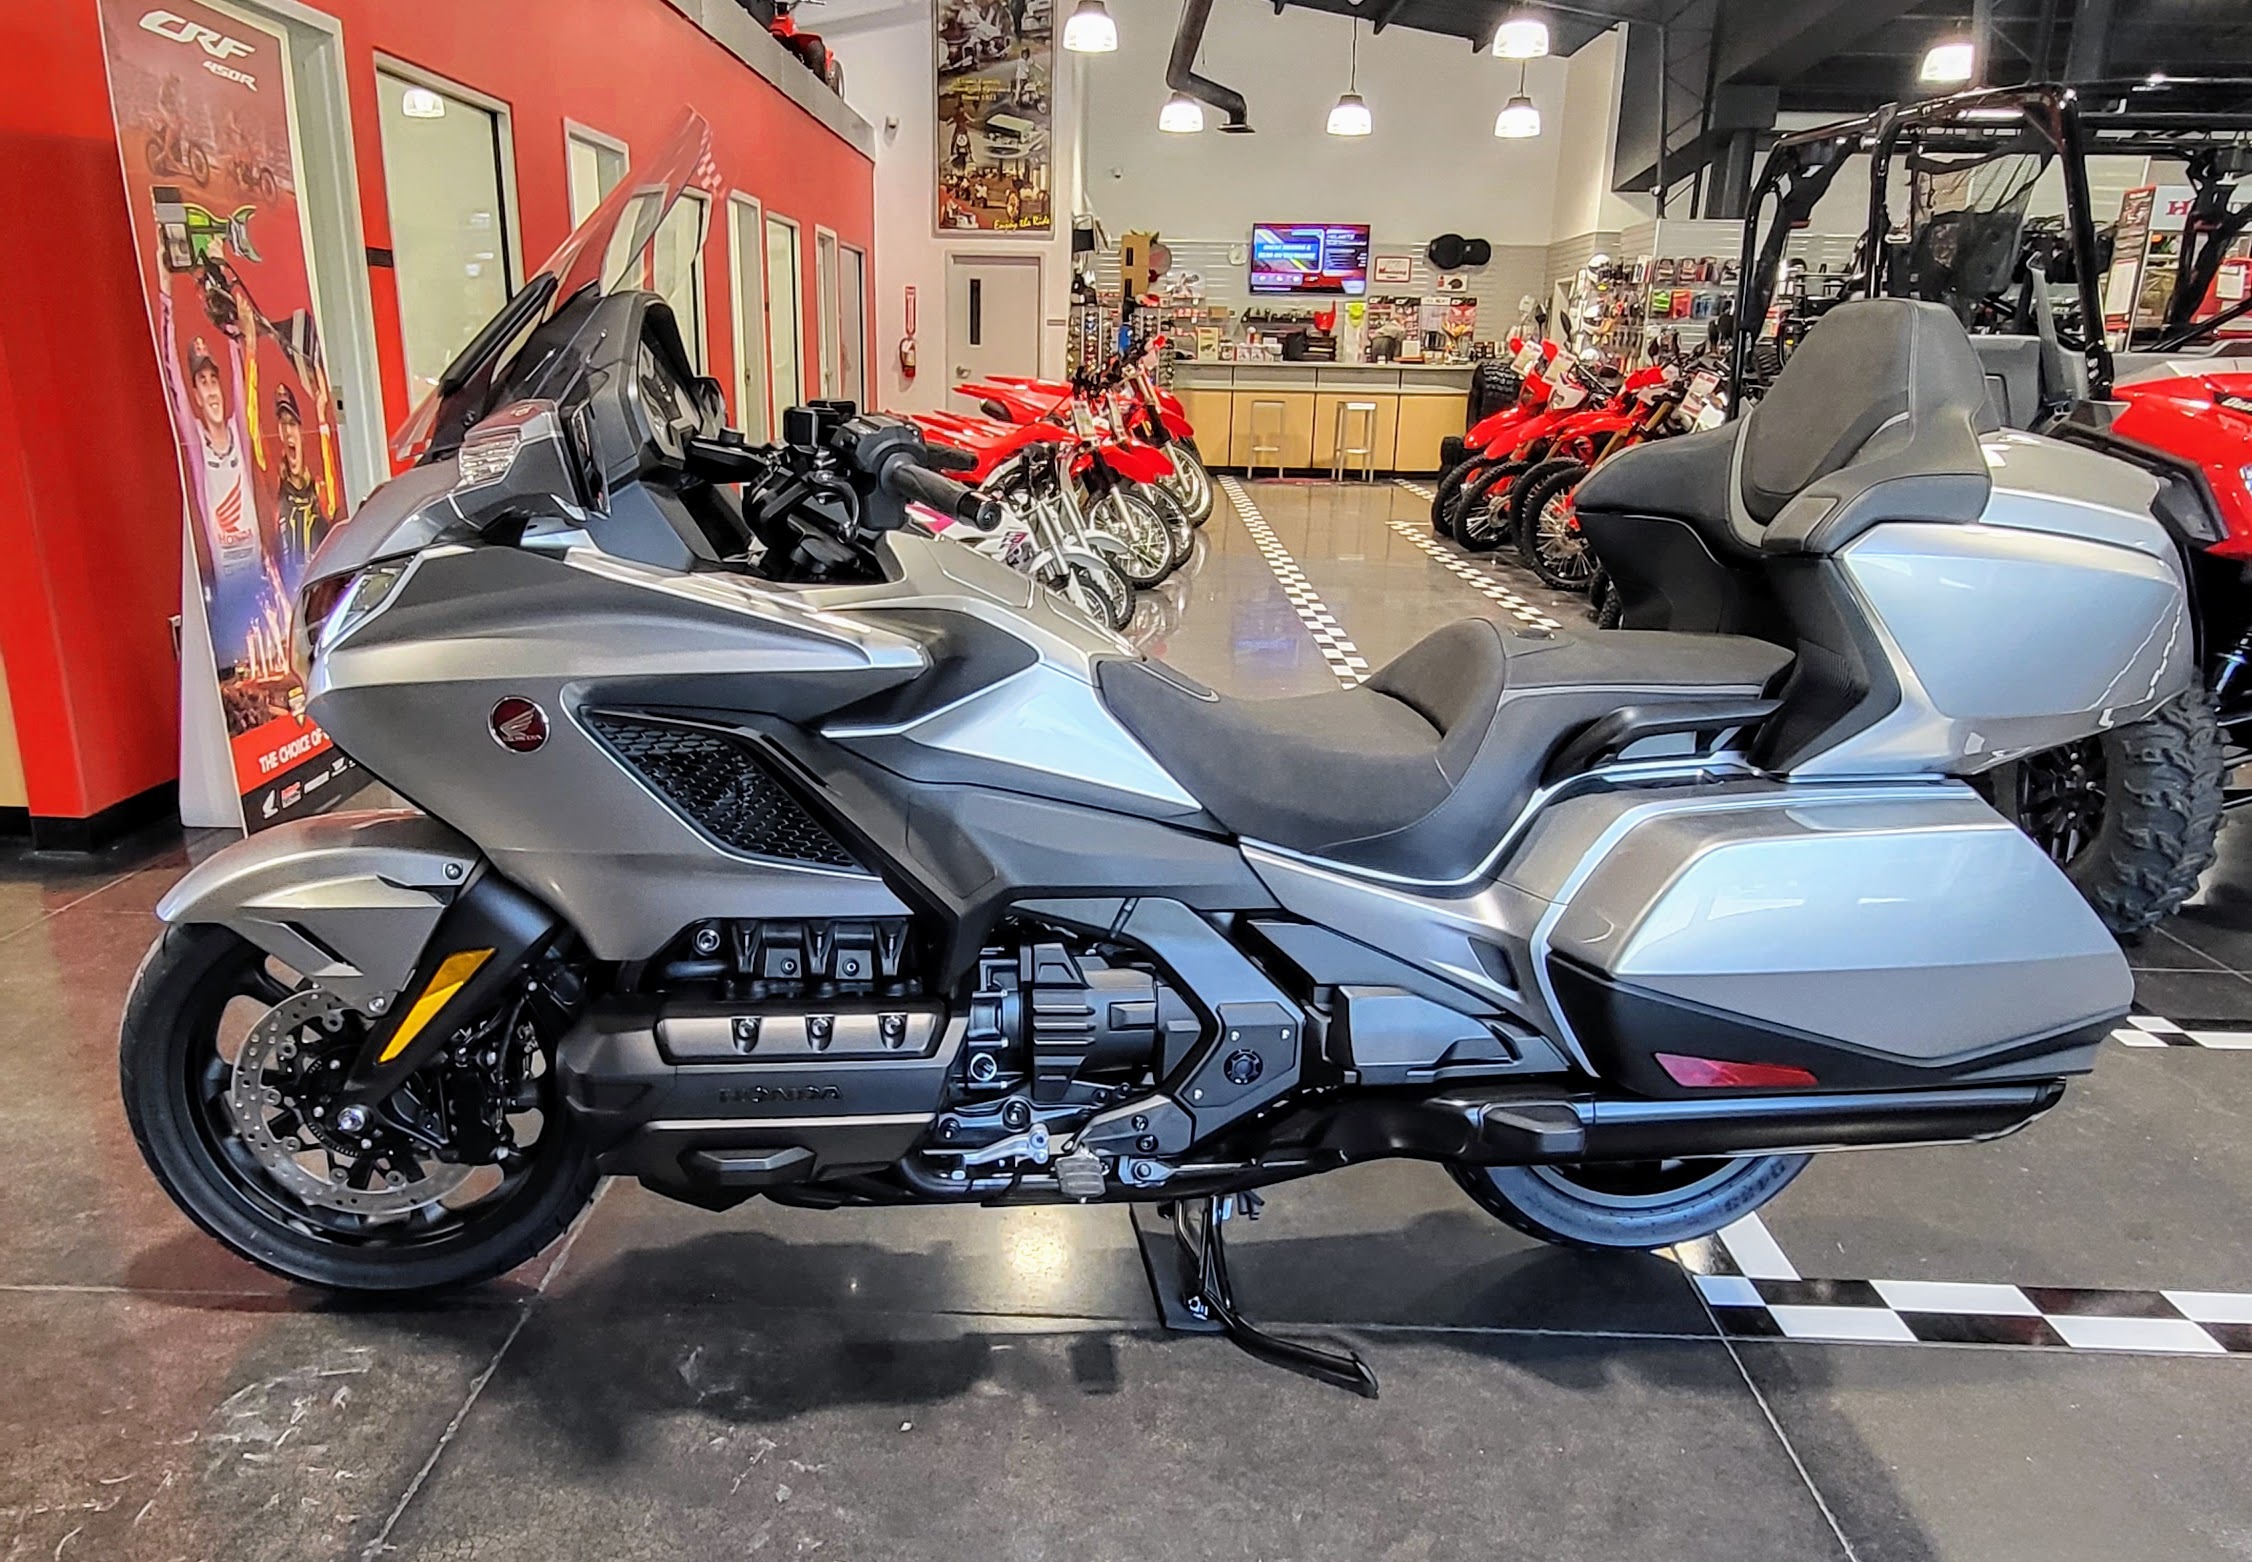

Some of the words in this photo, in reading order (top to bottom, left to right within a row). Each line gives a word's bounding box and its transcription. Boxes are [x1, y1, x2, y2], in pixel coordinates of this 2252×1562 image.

[138, 9, 256, 59] CRF
[202, 60, 258, 92] 450R
[993, 219, 1018, 233] Enjoy
[1032, 215, 1050, 226] Ride
[258, 751, 280, 774] THE
[278, 734, 312, 764] CHOICE
[718, 1085, 843, 1103] HONDA
